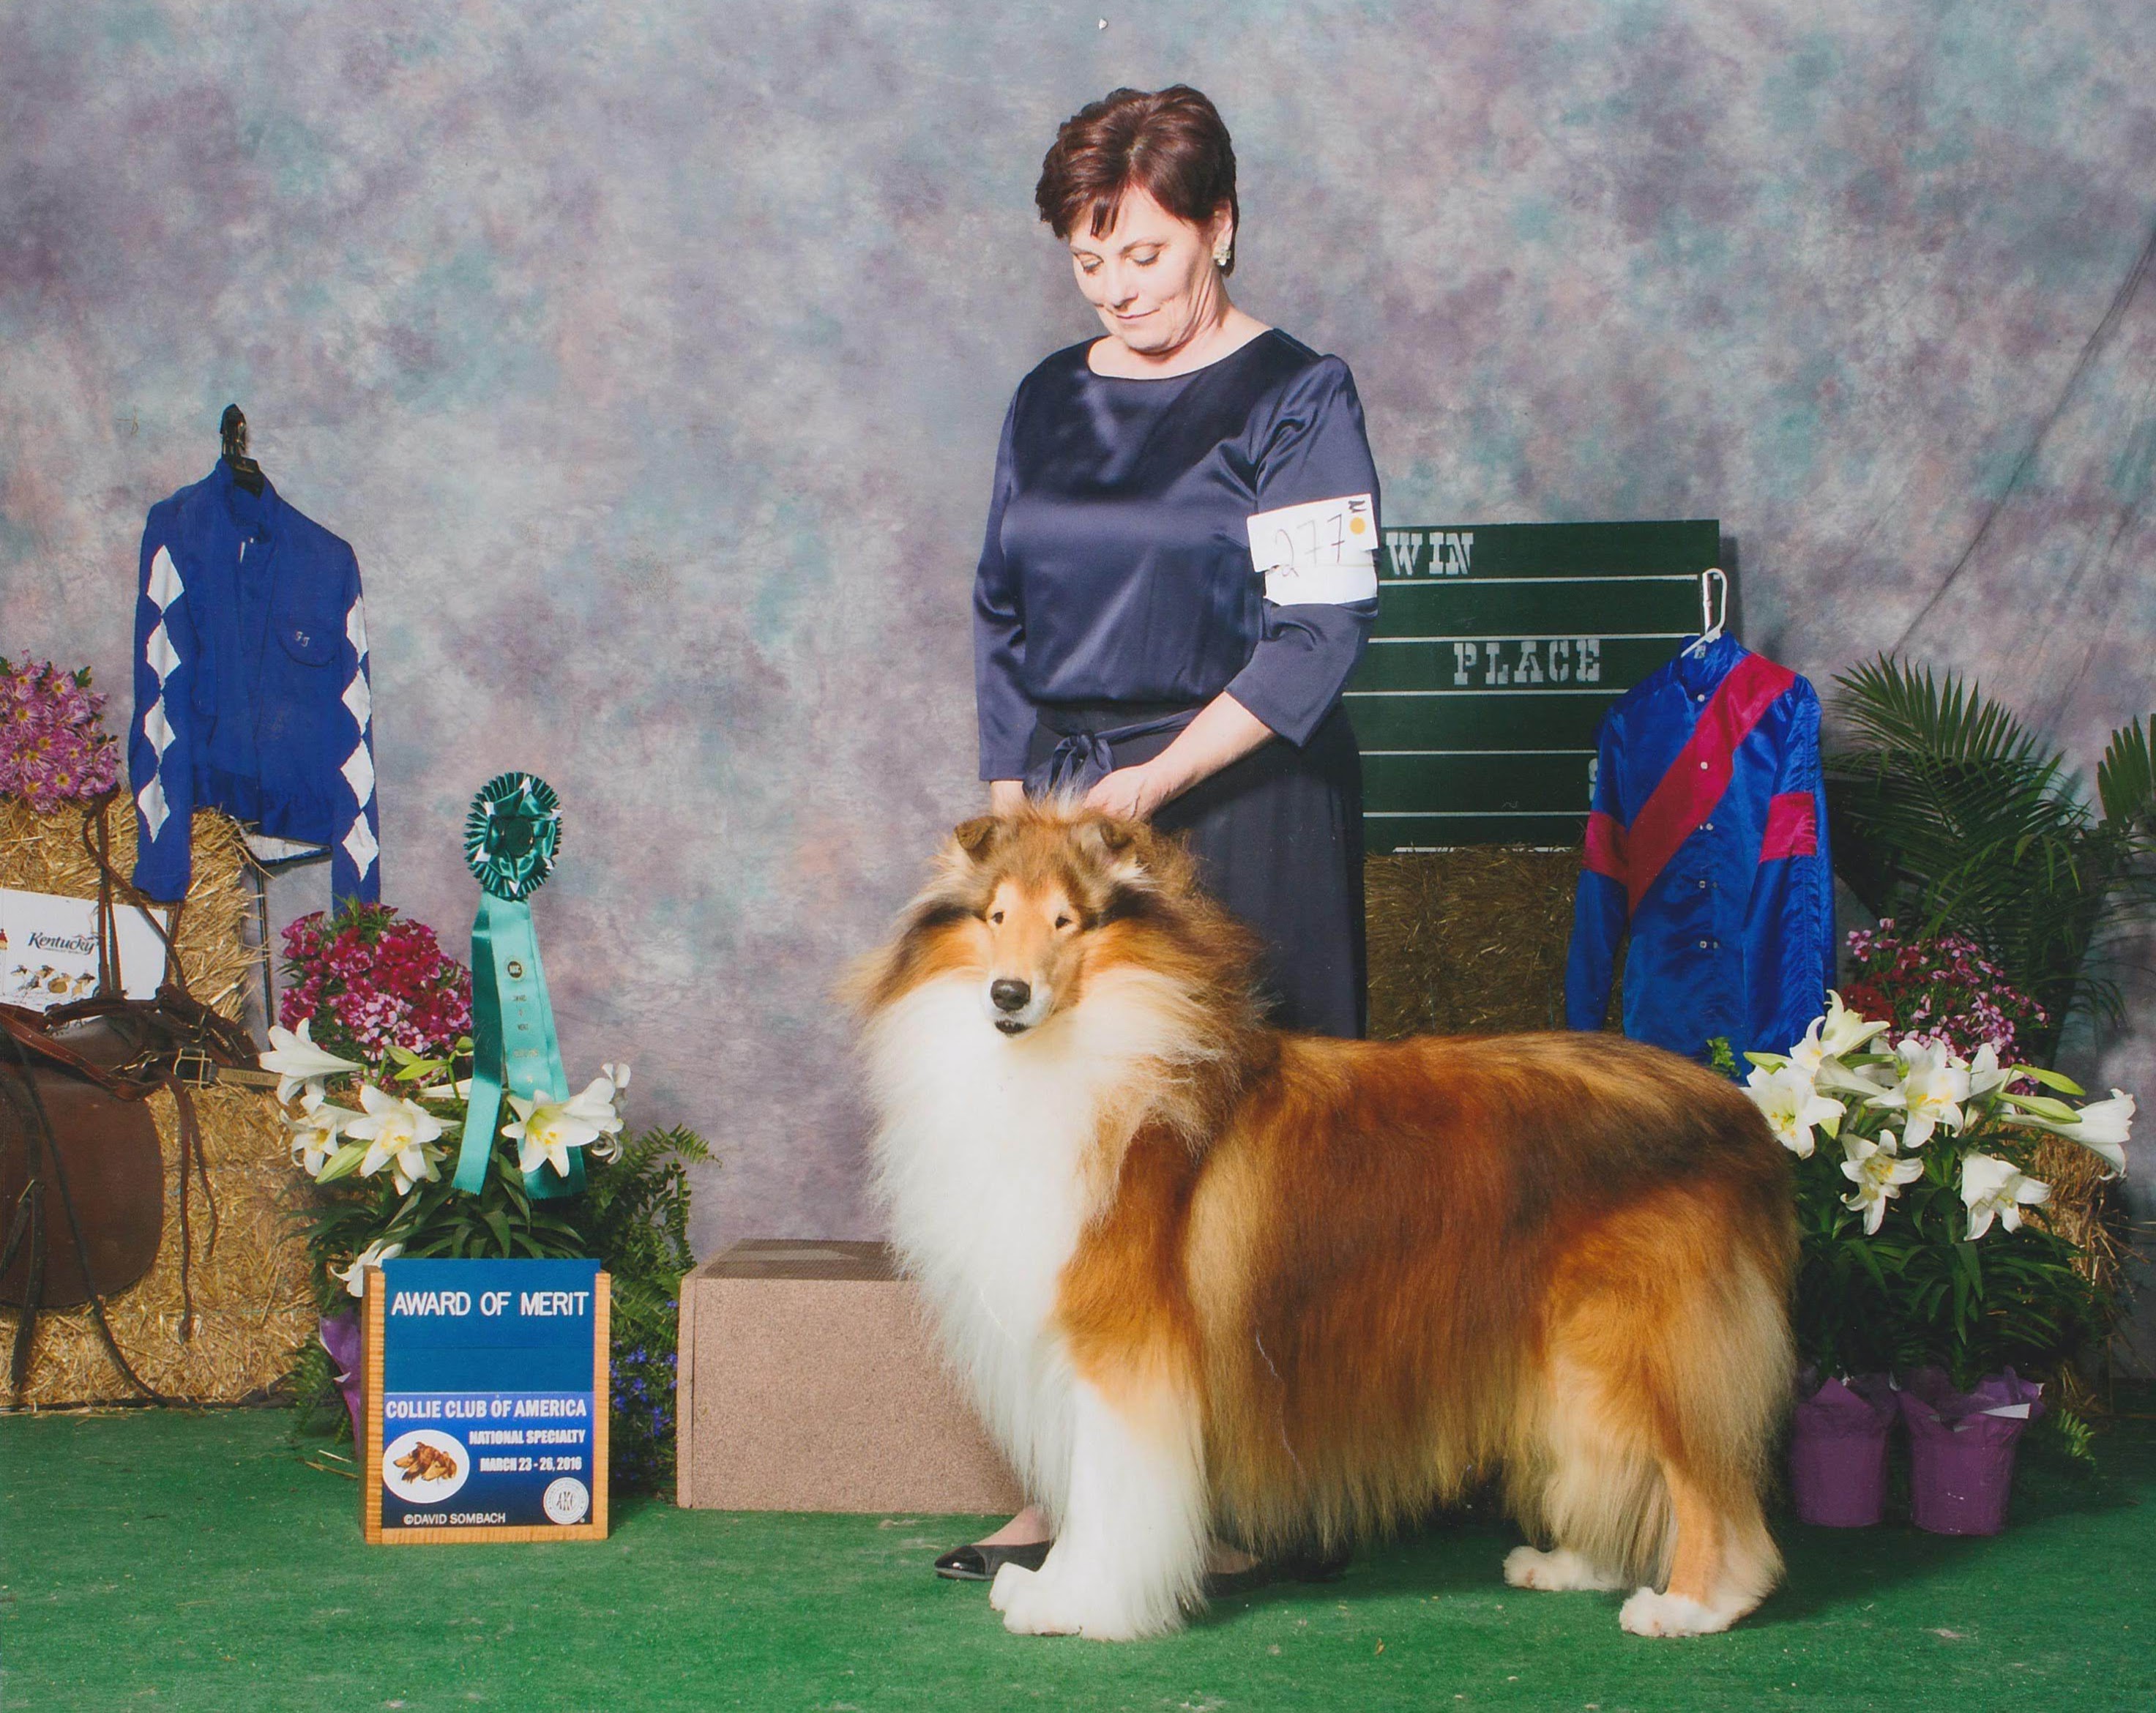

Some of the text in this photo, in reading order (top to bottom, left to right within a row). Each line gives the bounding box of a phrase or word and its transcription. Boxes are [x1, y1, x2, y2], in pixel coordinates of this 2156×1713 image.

[1275, 513, 1345, 577] 277
[1385, 531, 1474, 575] WIN
[1452, 638, 1601, 684] PLACE
[28, 931, 95, 955] Kentucky
[391, 1291, 589, 1315] AWARD OF MERIT
[386, 1398, 587, 1419] COLLIE CLUB OF AMERICA
[469, 1429, 586, 1445] NATIONAL SPECIALTY
[480, 1458, 518, 1471] MARCH
[518, 1457, 532, 1471] 23
[540, 1456, 556, 1472] 26,
[556, 1456, 583, 1471] 2016
[450, 1512, 506, 1524] SOMBACH
